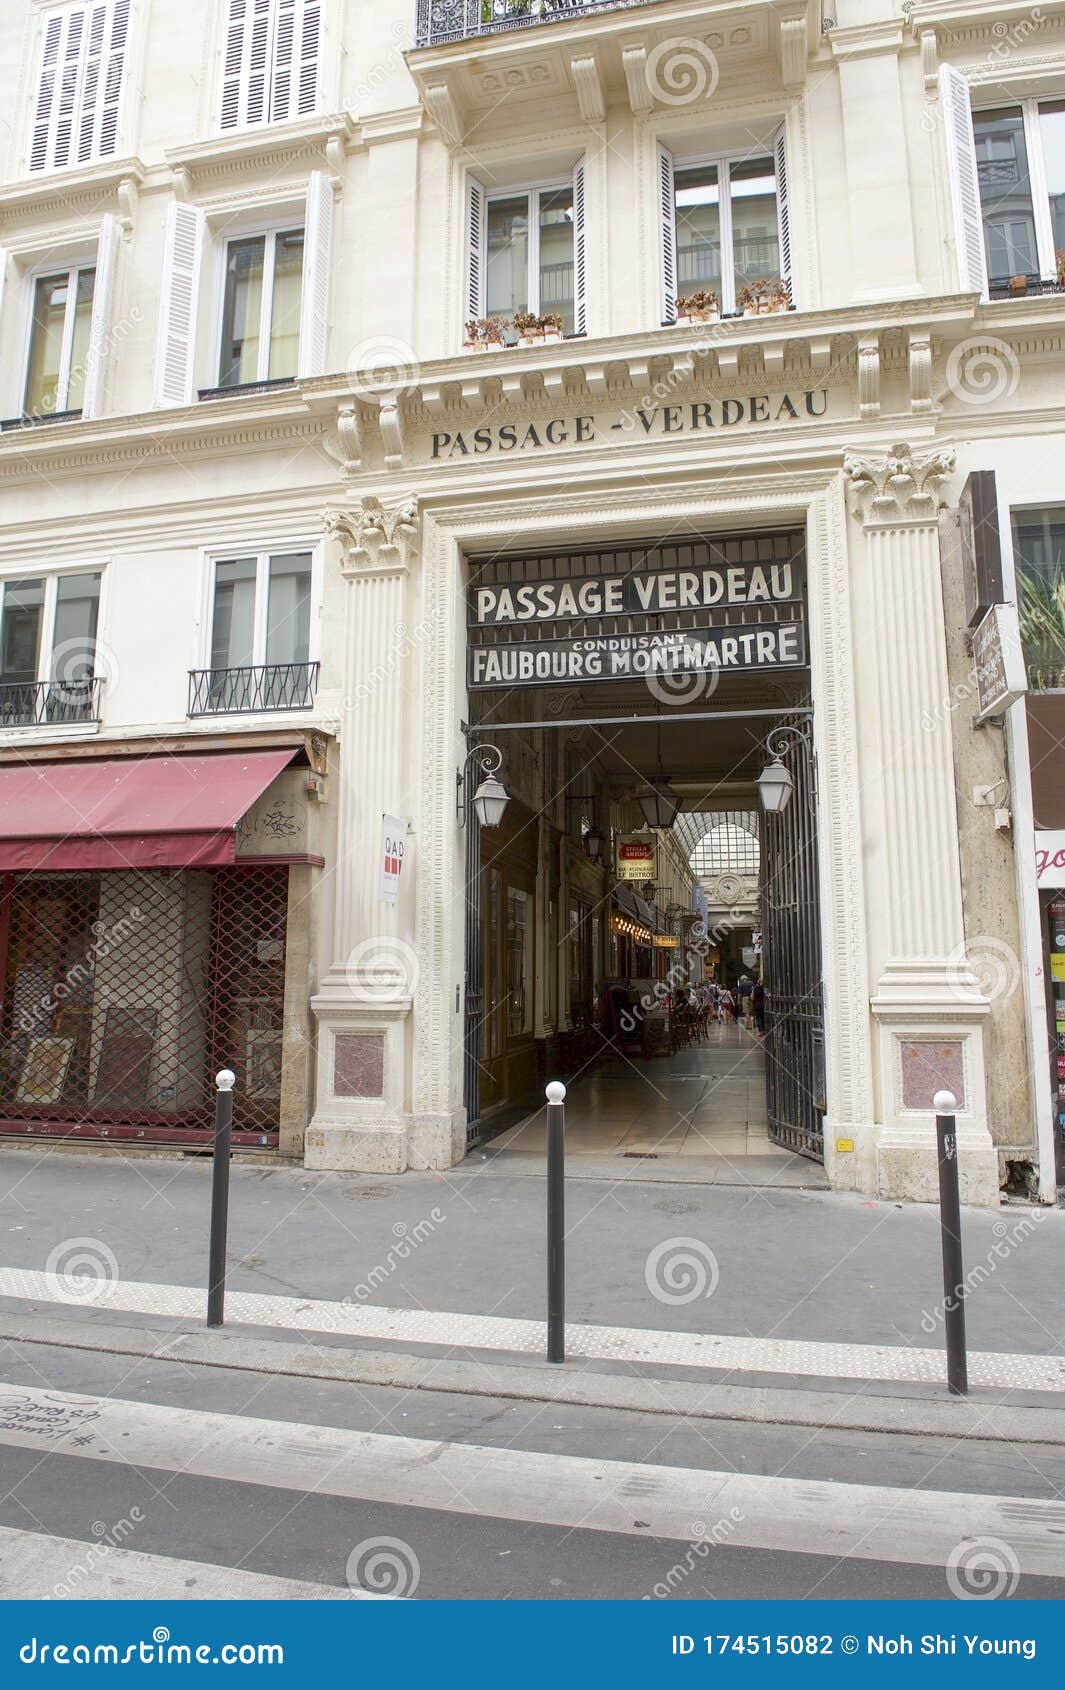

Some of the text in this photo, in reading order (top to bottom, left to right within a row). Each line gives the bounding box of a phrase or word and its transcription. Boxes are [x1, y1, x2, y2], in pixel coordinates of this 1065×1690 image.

[431, 416, 595, 459] PASSAGE
[637, 388, 829, 434] VERDEAU
[477, 564, 793, 622] PASSAGE VERDEAU
[474, 627, 799, 682] FAUBOURG MONTMARTRE
[573, 634, 687, 651] CONDUISANT
